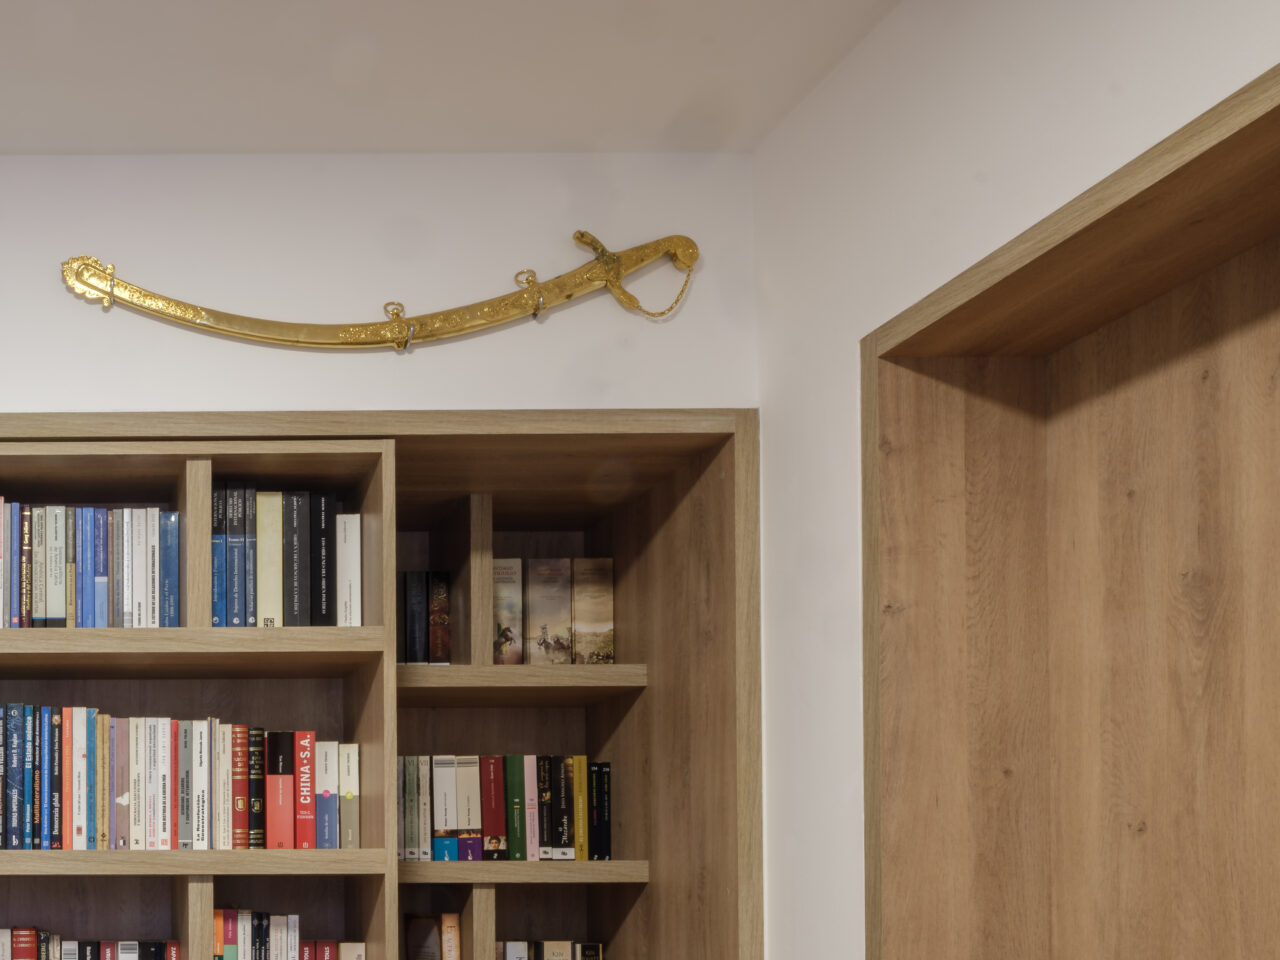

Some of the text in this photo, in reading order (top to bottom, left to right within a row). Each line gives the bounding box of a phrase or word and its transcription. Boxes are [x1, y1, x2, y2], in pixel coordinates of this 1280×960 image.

[300, 734, 311, 804] CHINA S.A.
[52, 792, 60, 807] global
